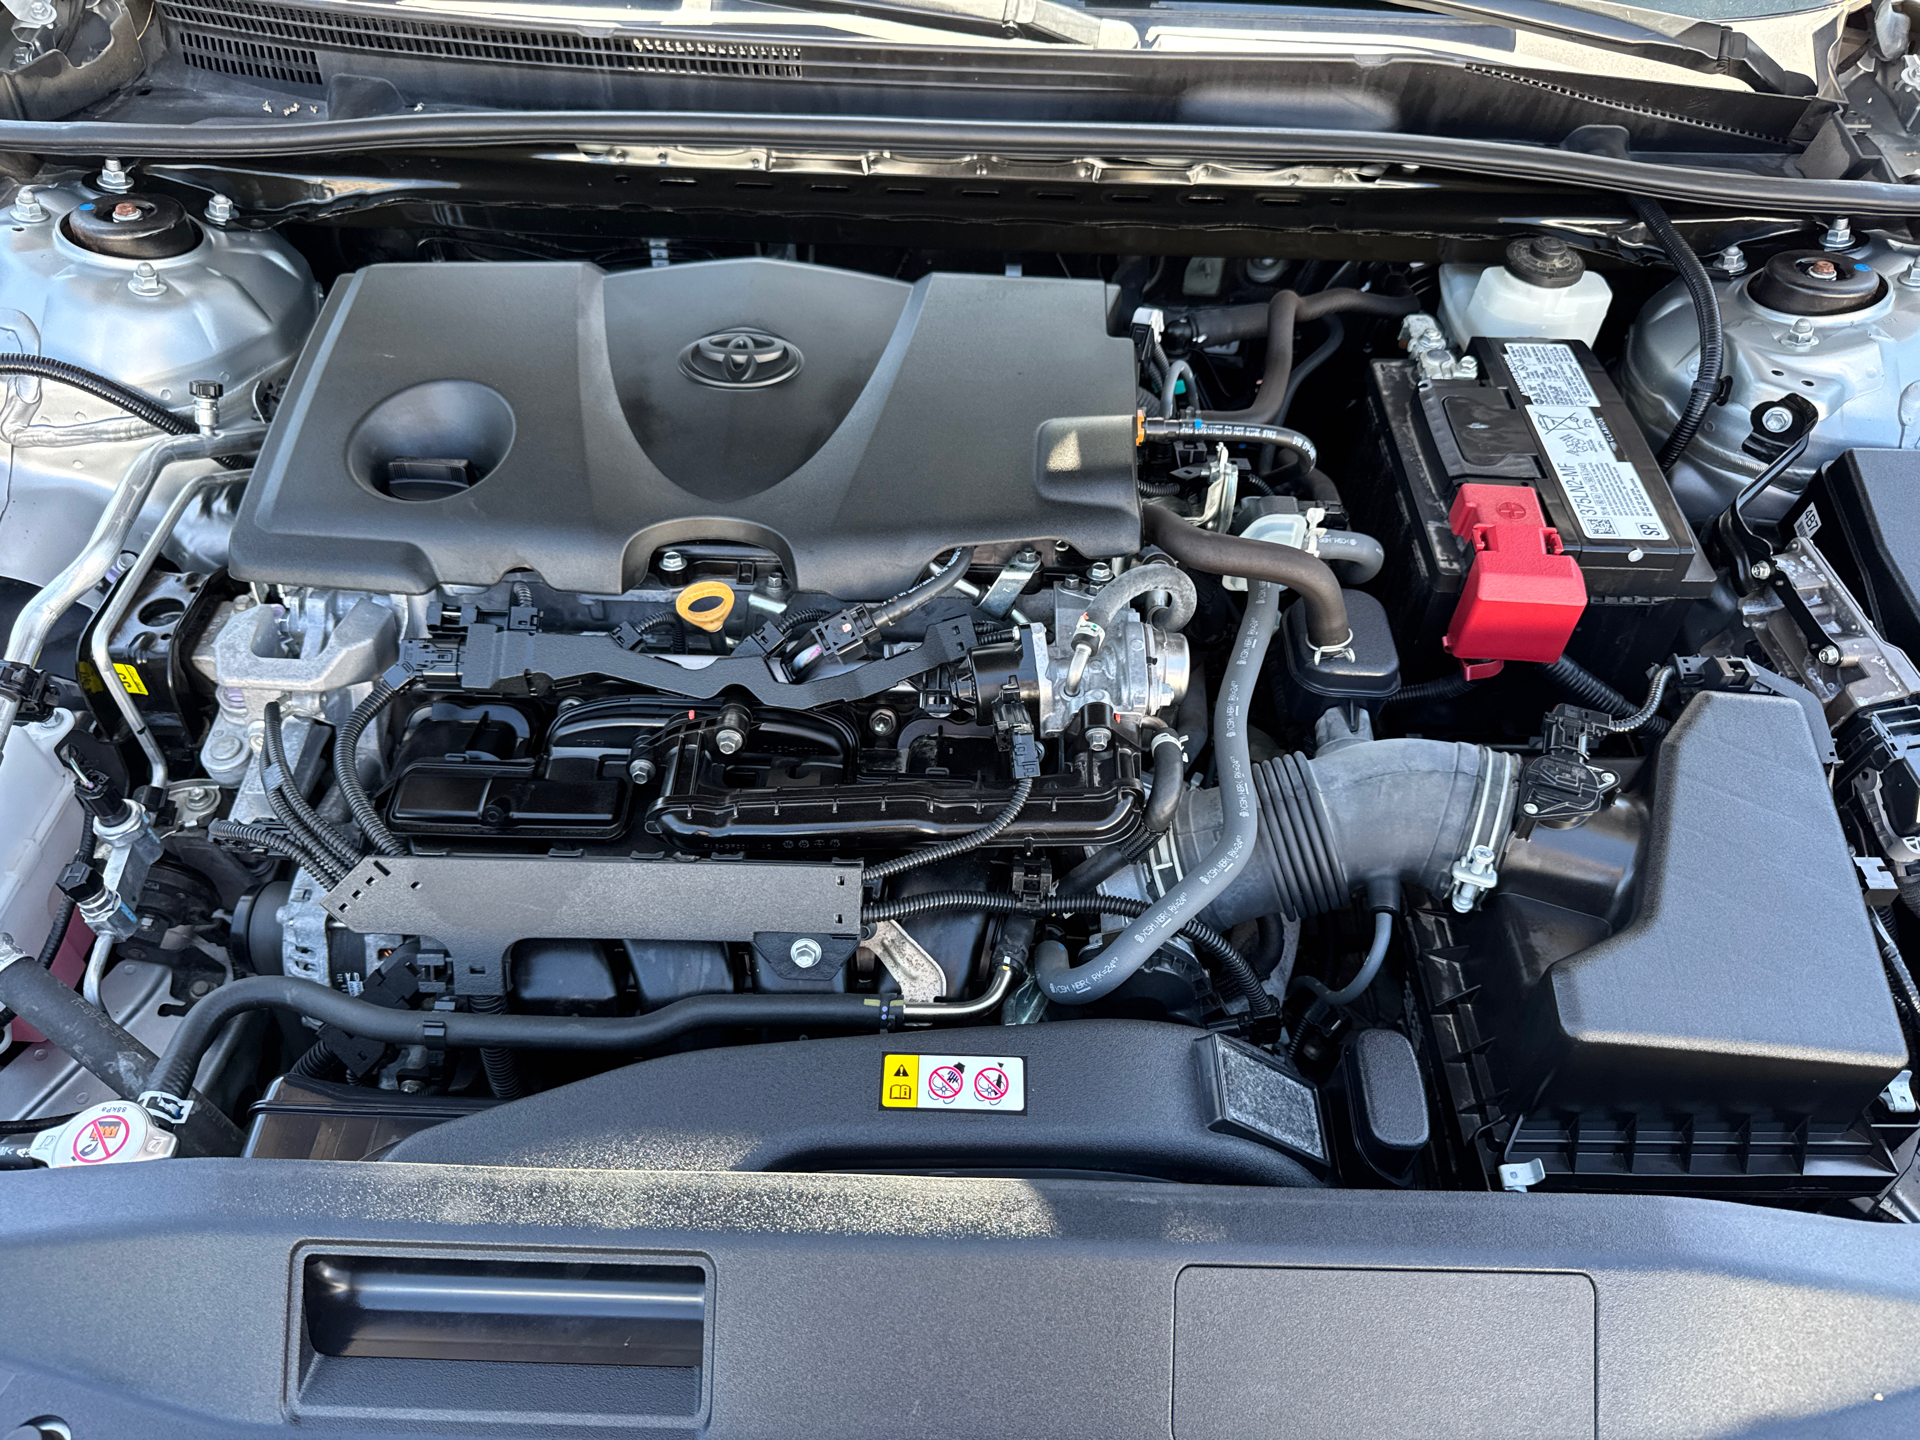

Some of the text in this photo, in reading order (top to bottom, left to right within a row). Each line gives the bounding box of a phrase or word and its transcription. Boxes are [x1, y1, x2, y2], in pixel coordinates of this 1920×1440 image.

[1596, 417, 1614, 442] CLARIOS
[1557, 463, 1597, 515] 375LN2-MF
[1640, 524, 1660, 536] SP
[1804, 509, 1819, 532] 4B7
